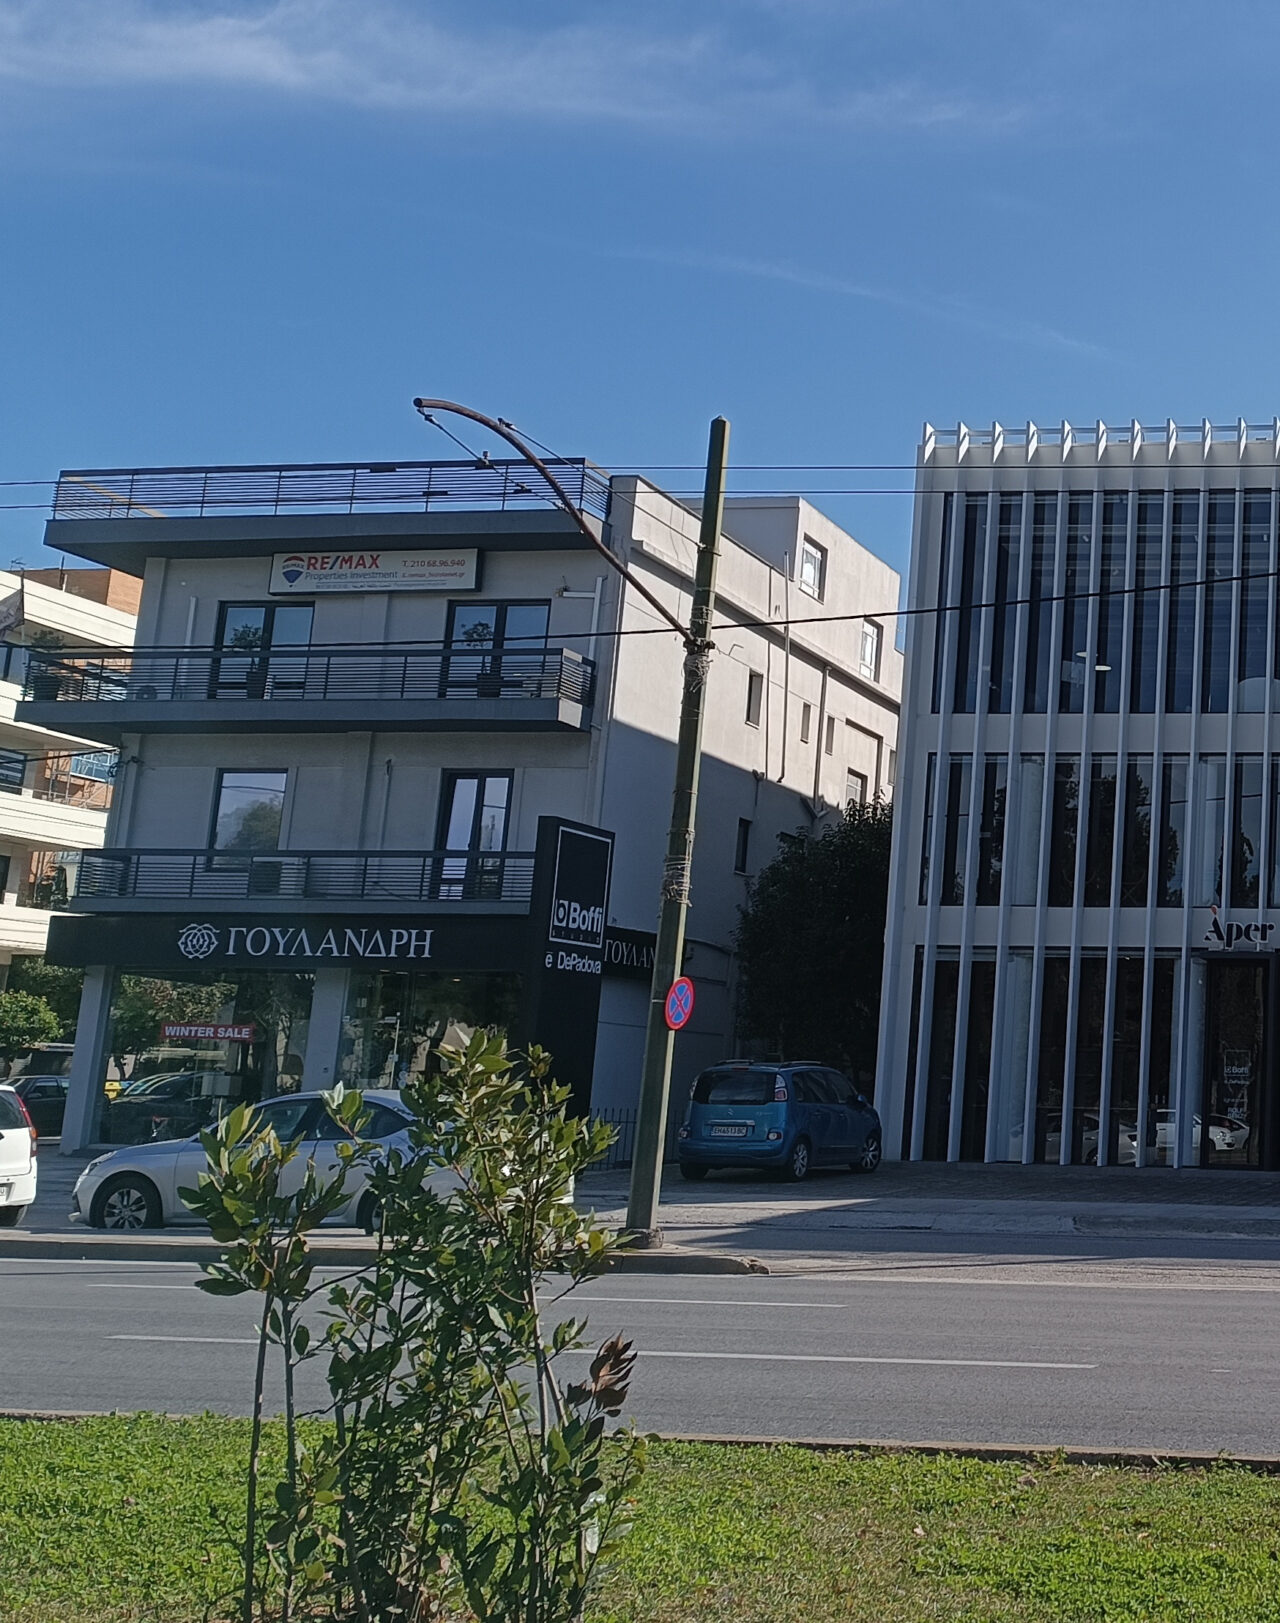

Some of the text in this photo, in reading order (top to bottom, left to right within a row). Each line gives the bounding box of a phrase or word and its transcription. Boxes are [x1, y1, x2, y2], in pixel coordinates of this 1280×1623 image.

[307, 554, 381, 570] RE/MAX
[304, 571, 348, 581] Properties
[568, 902, 602, 933] Boffi
[225, 927, 434, 958] ΓΟΥΛΑΝΔΡΗ
[557, 951, 602, 974] DePadova
[164, 1026, 250, 1039] WINTER SALE
